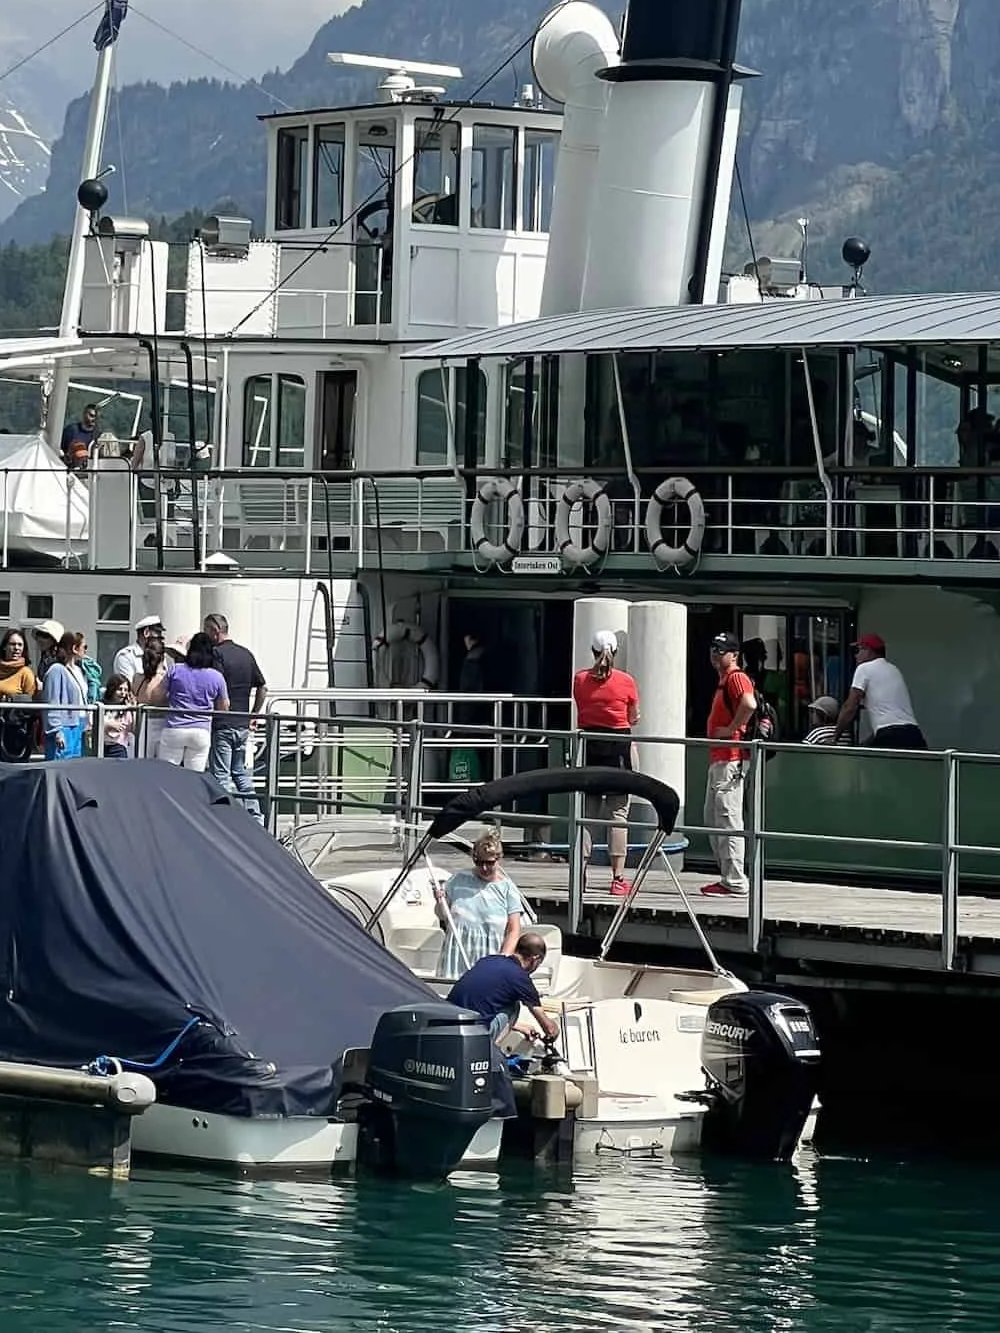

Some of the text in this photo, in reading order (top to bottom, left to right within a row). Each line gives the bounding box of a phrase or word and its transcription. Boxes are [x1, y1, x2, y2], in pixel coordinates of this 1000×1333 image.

[629, 1028, 660, 1042] baron
[415, 1061, 456, 1080] YAMAHA
[470, 1061, 489, 1071] 100
